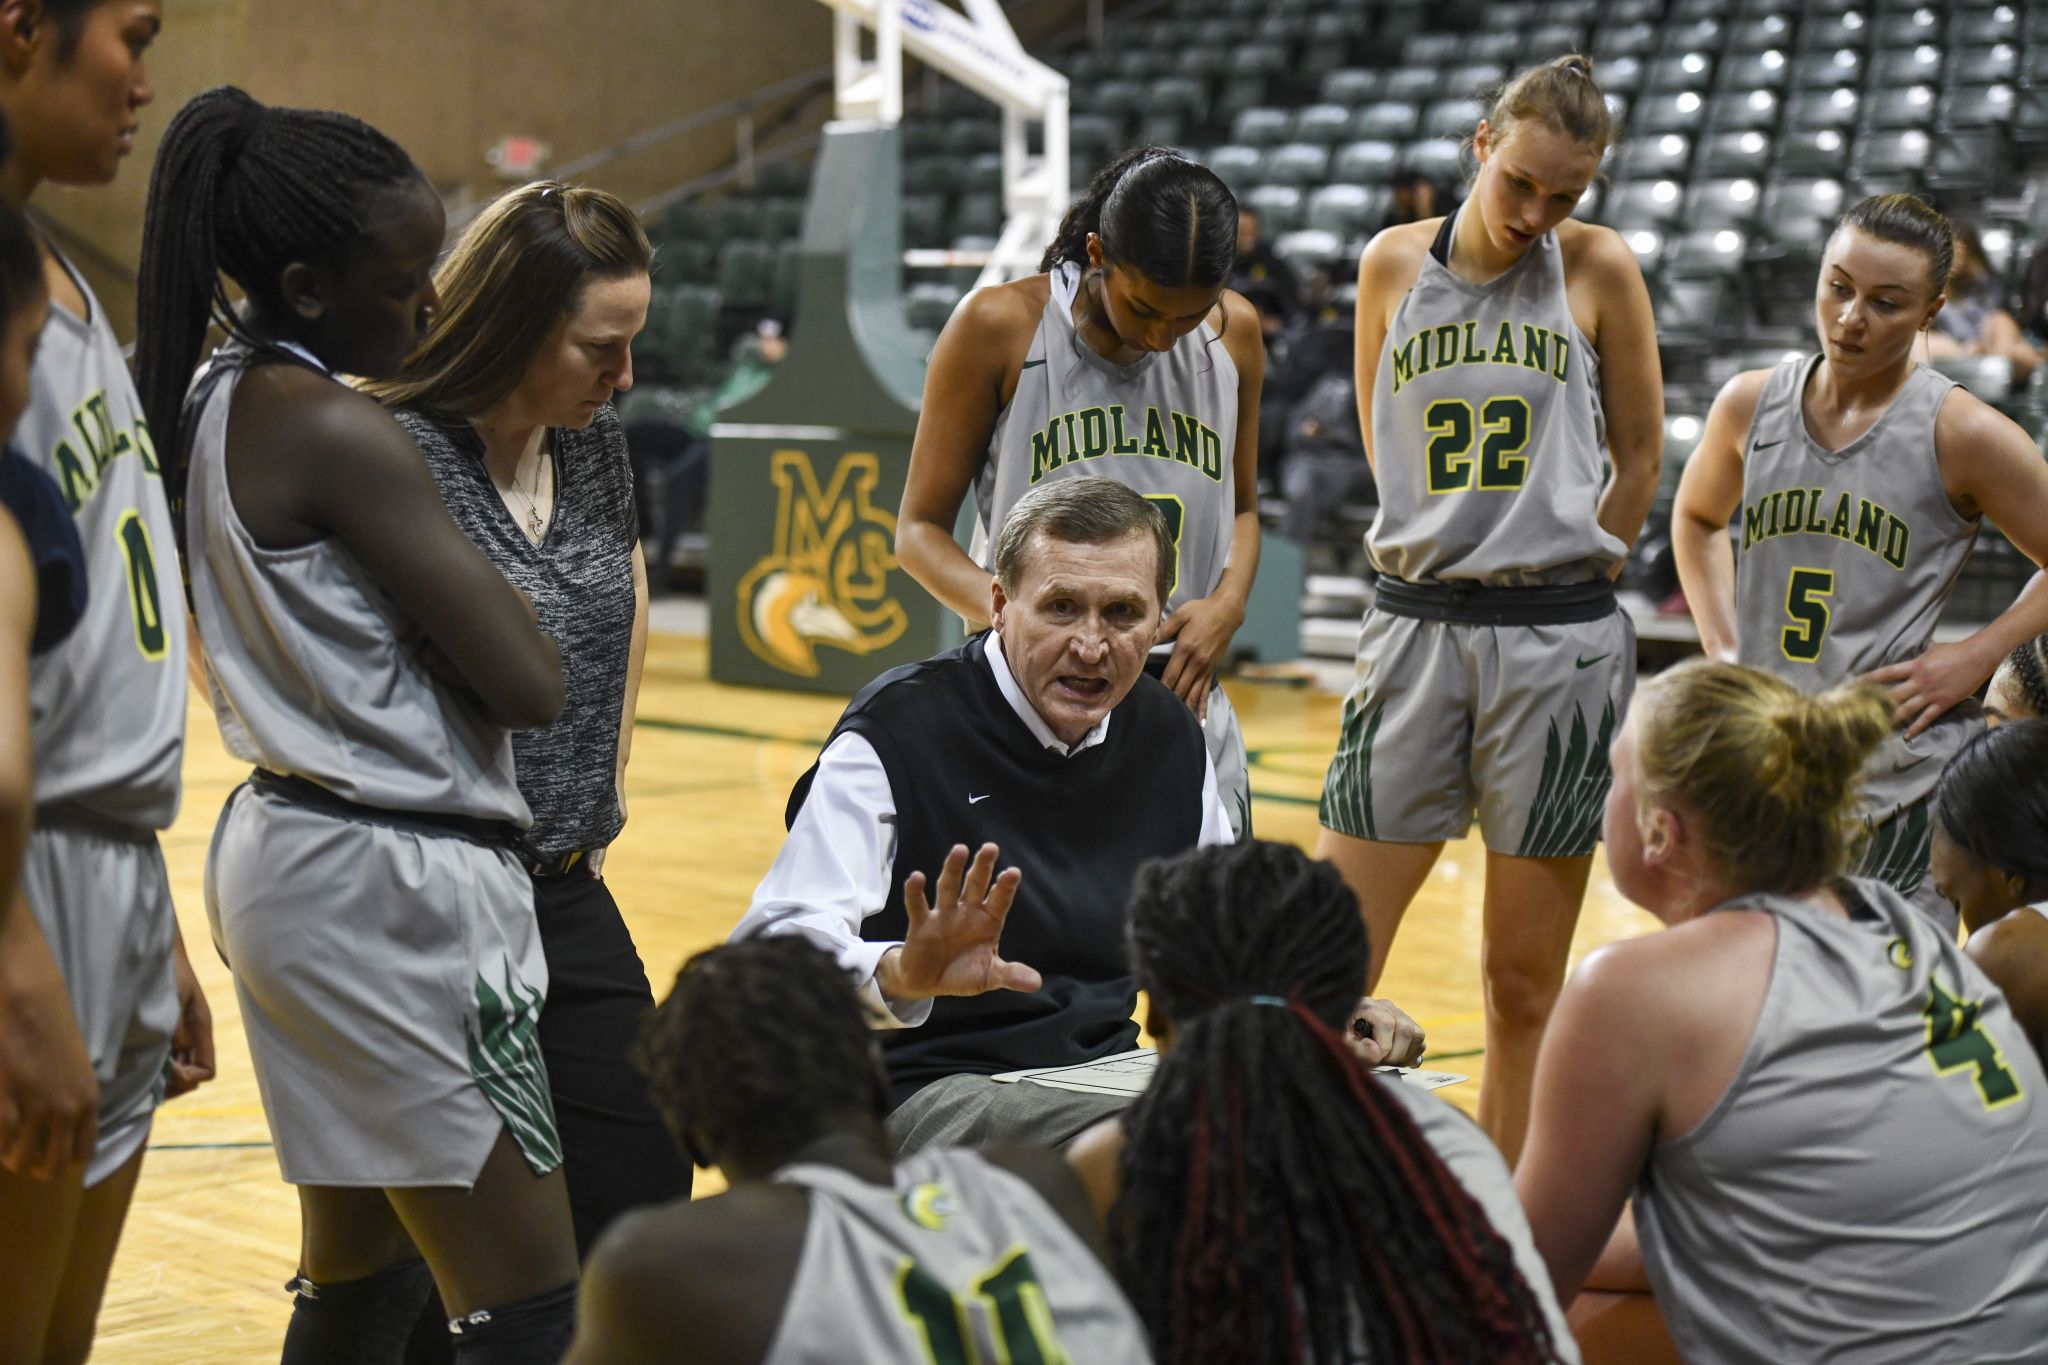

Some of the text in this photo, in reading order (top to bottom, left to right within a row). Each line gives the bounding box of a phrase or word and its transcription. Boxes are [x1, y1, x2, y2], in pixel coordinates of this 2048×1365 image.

[1393, 320, 1569, 396] MIDLAND
[1029, 404, 1223, 485] MIDLAND
[1424, 396, 1531, 495] 22
[1743, 487, 1910, 571] MIDLAND
[1781, 566, 1835, 663] 5
[1921, 970, 2025, 1112] 4
